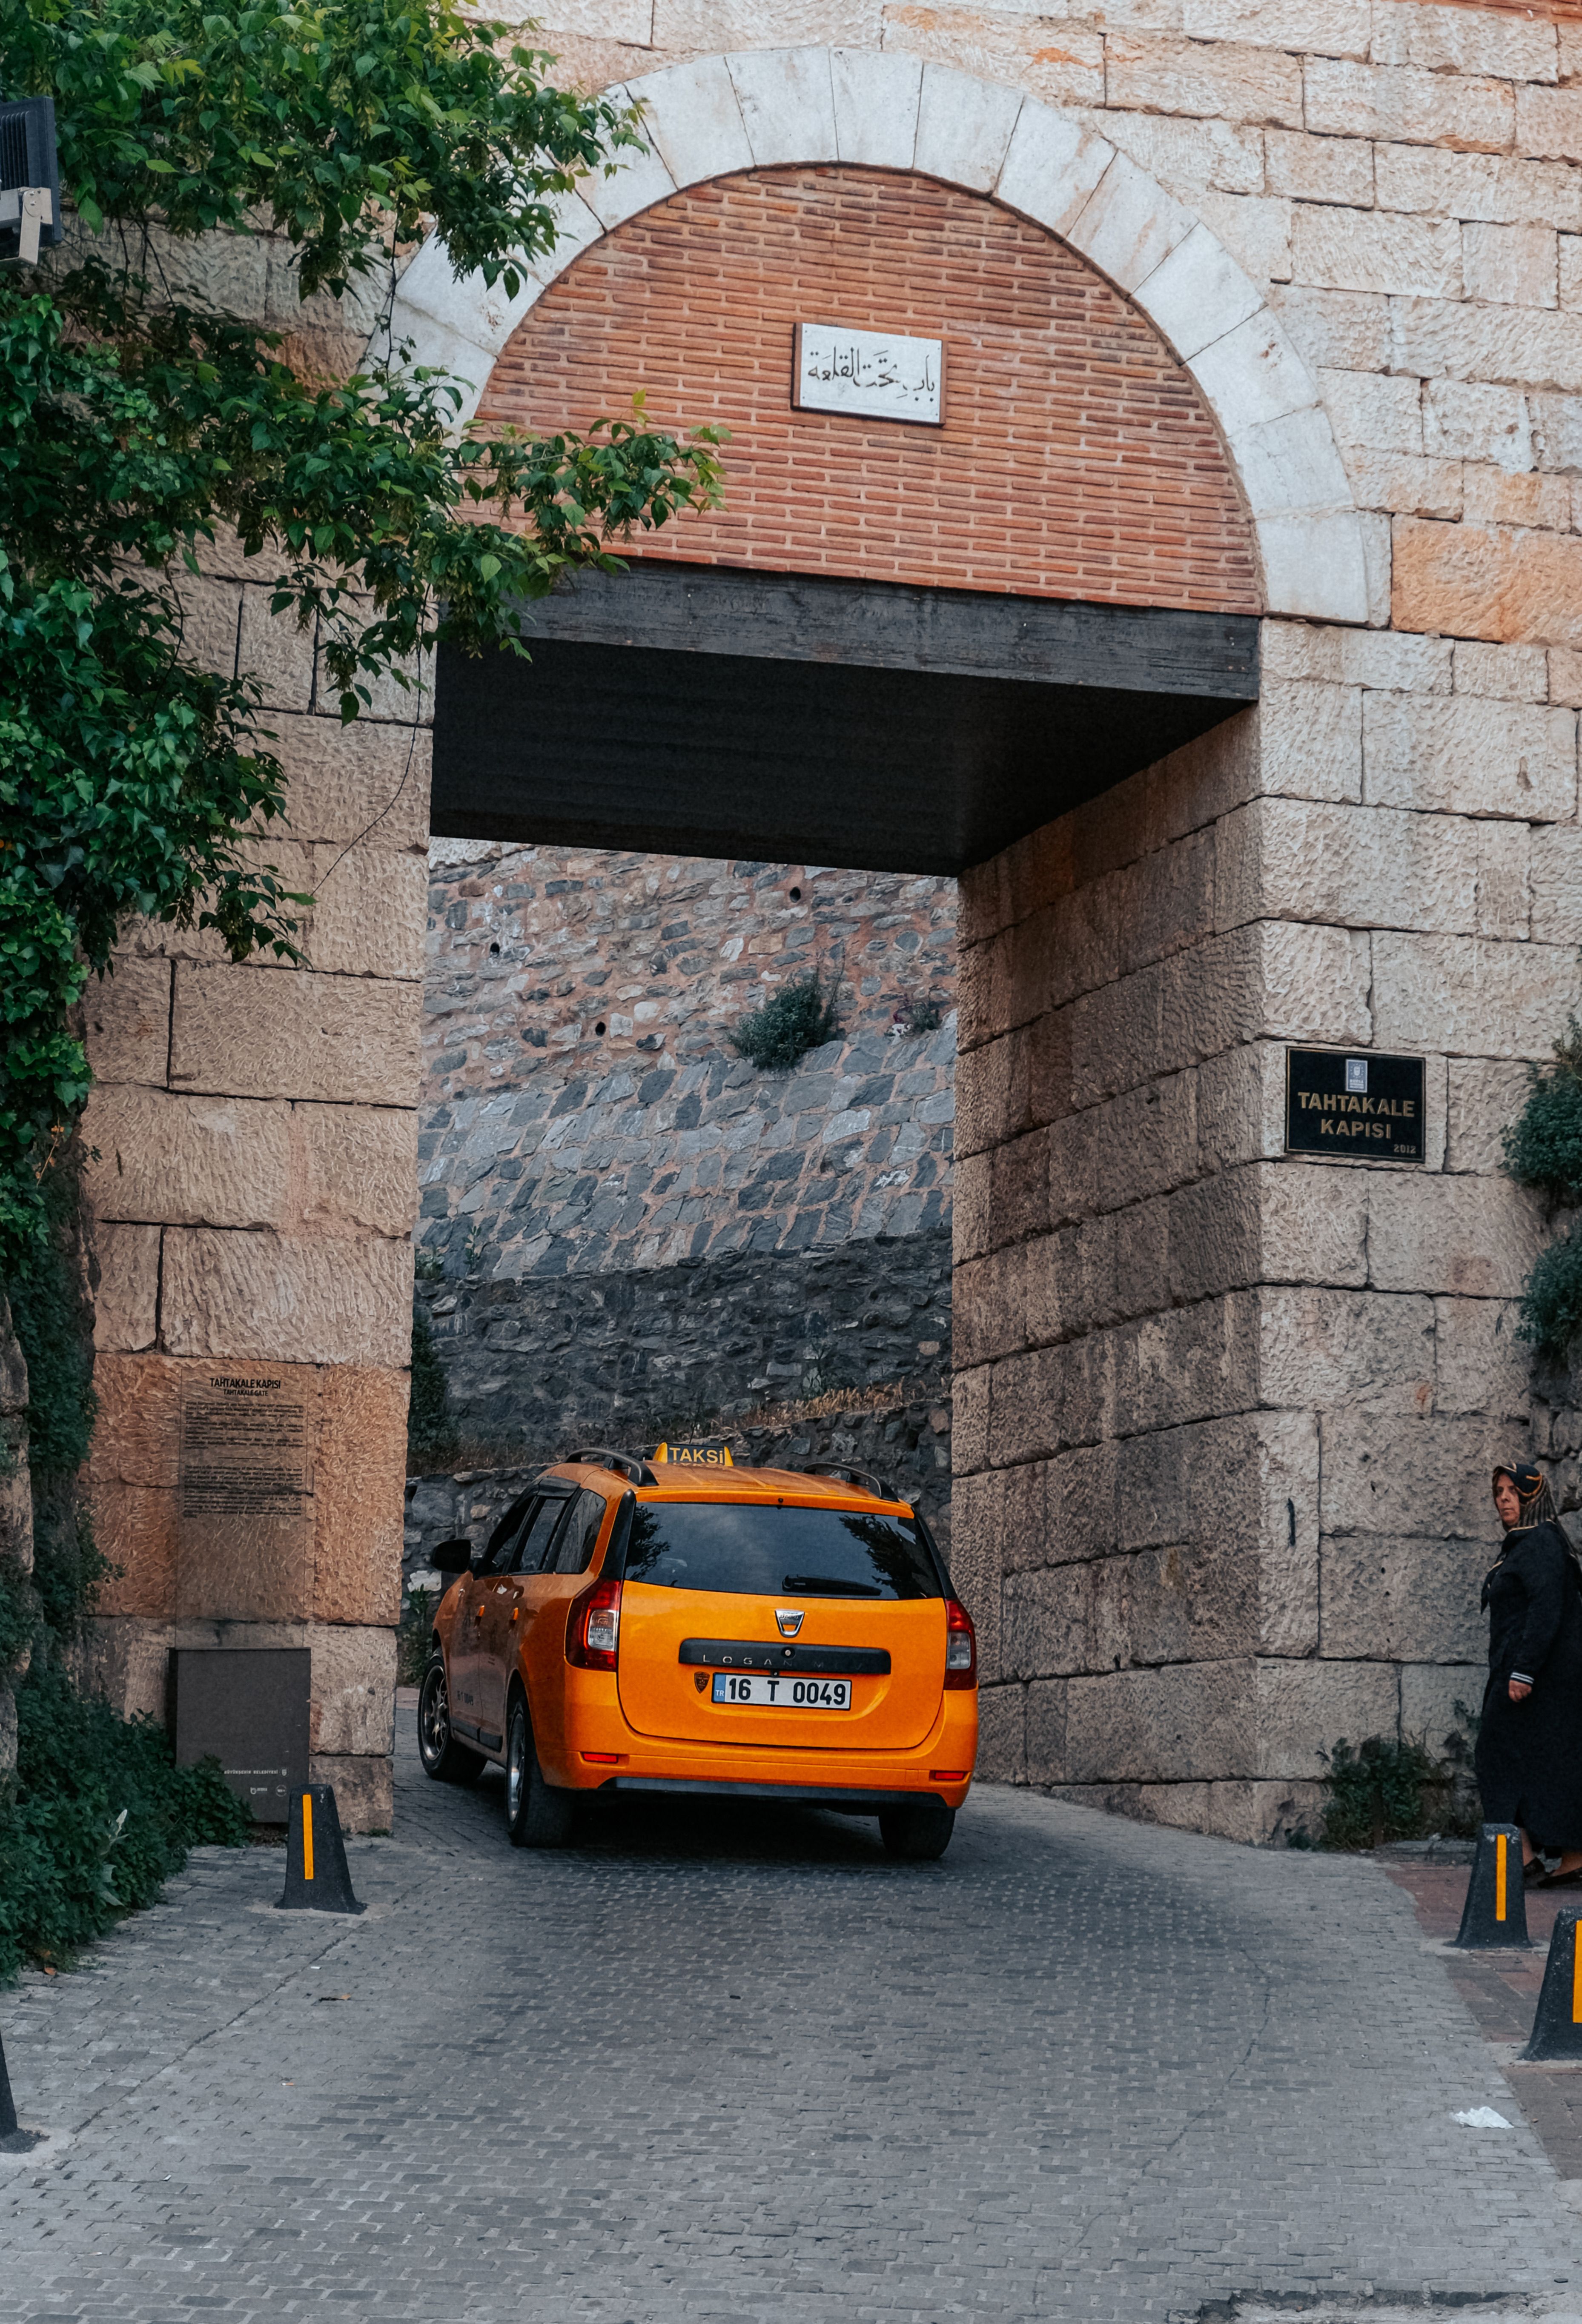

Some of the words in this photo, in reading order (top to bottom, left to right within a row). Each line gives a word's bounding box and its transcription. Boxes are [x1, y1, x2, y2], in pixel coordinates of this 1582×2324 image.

[1298, 1092, 1415, 1118] TAHTAKALE
[1320, 1118, 1391, 1139] KAPISI
[1393, 1144, 1417, 1154] 2012
[210, 1377, 255, 1388] TAHTAKALE
[256, 1379, 281, 1389] KAPISI
[702, 1654, 793, 1667] LOGAN
[729, 1678, 752, 1700] 16
[767, 1680, 780, 1702] T
[792, 1681, 846, 1706] 0049
